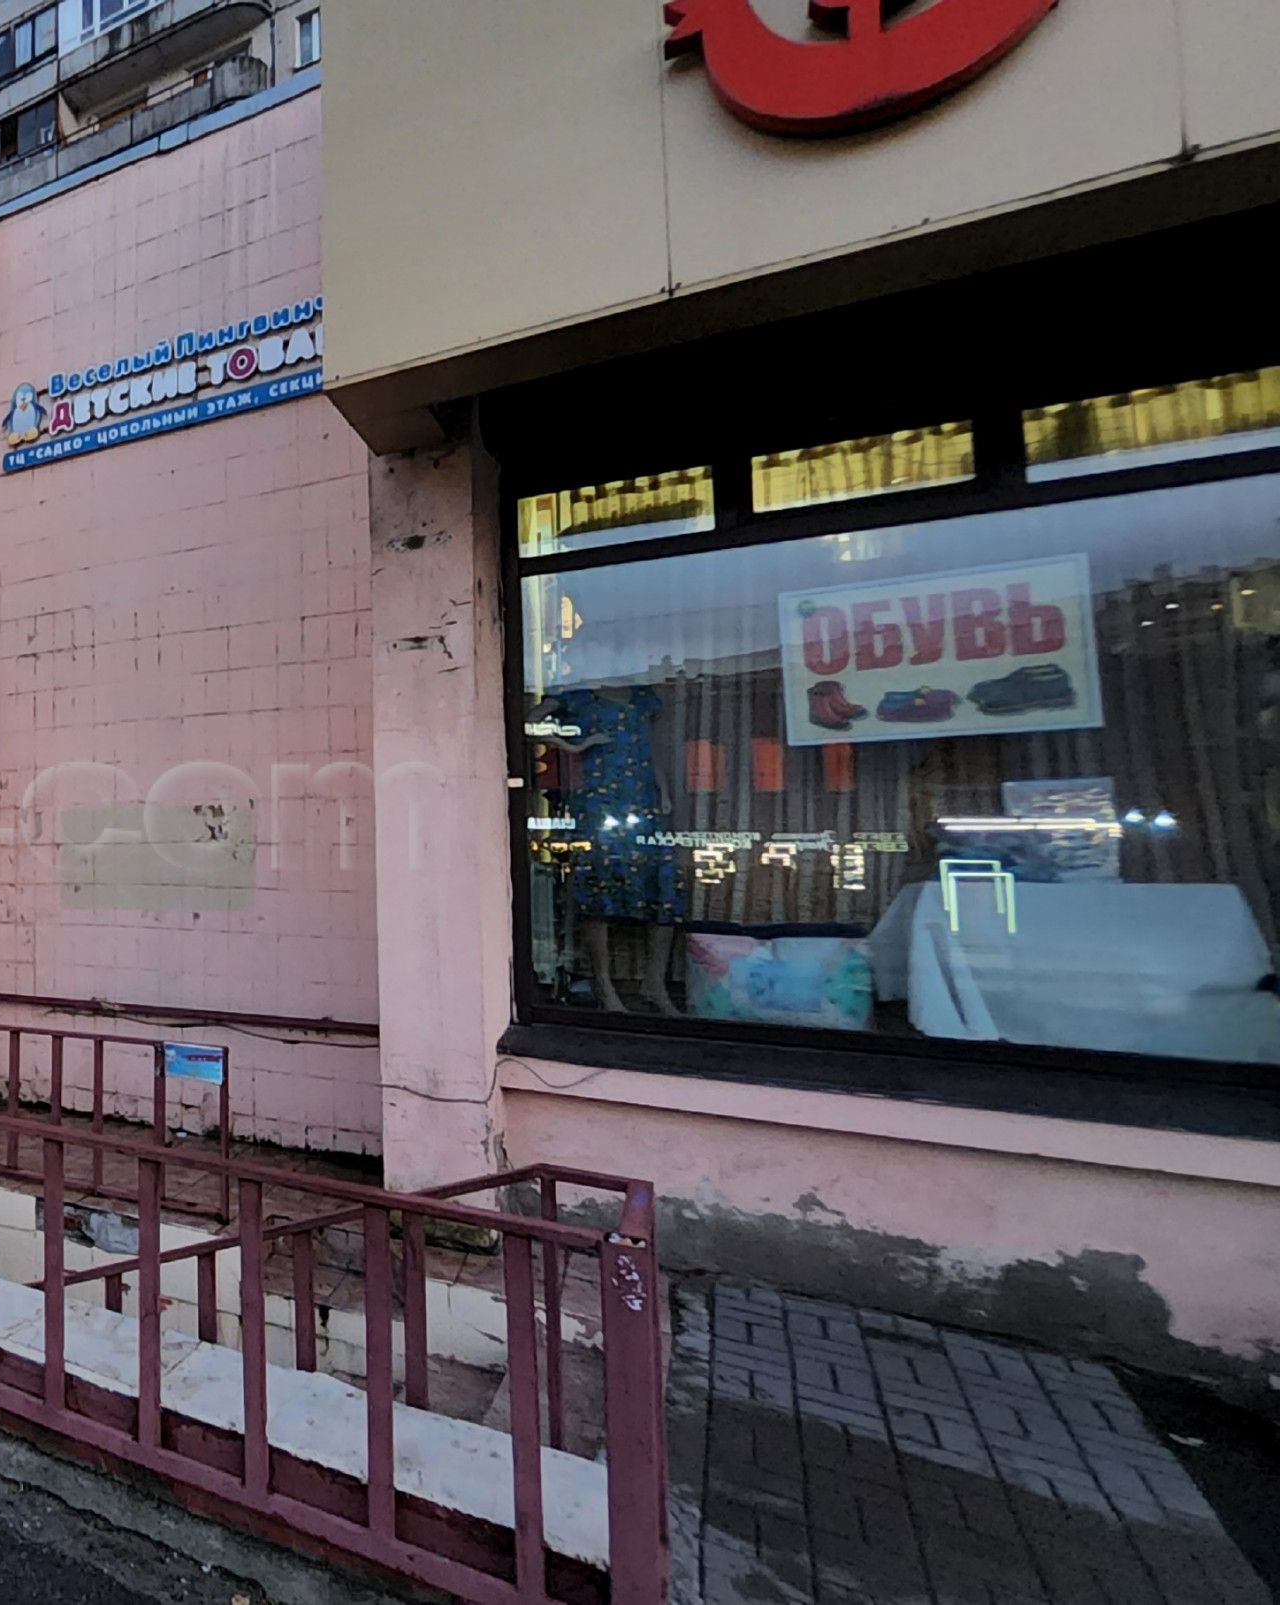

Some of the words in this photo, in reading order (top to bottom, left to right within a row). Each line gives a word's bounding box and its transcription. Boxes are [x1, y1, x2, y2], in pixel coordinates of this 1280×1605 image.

[48, 339, 172, 397] Веселый
[49, 361, 197, 435] ДЕТСКИЕ
[802, 582, 1066, 676] ОБУВЬ
